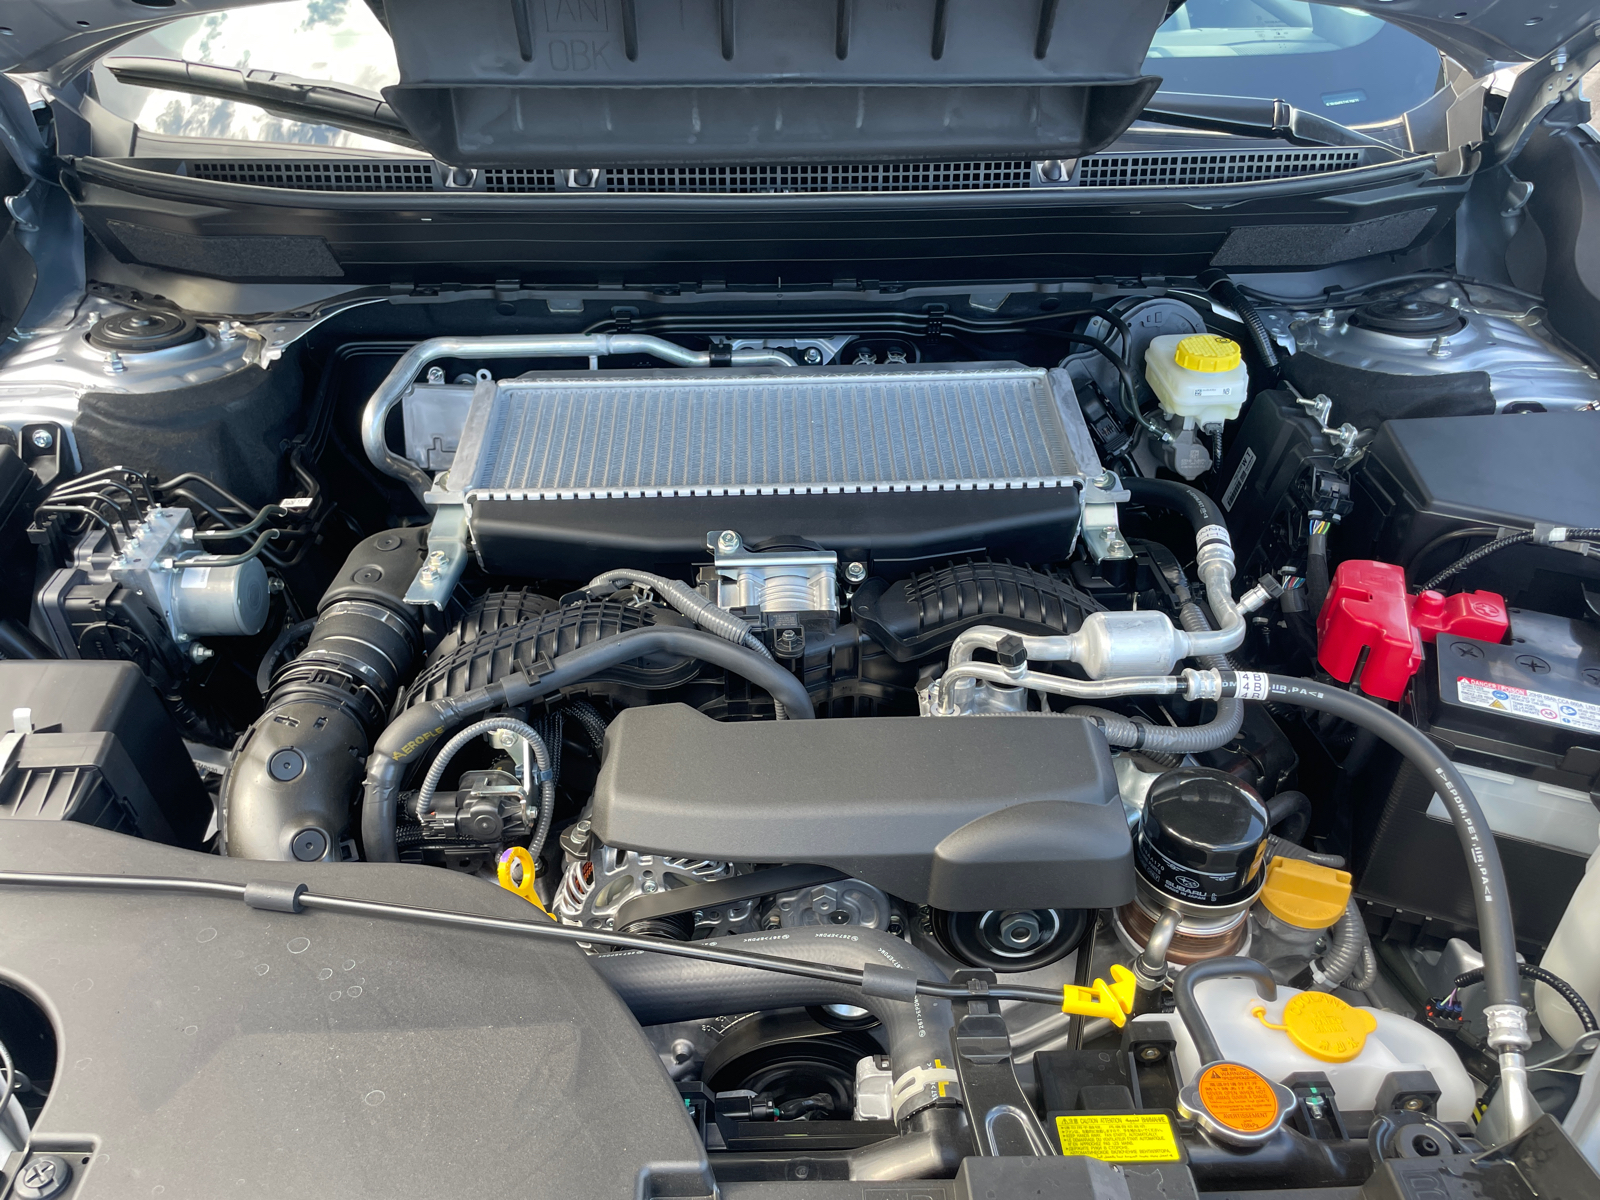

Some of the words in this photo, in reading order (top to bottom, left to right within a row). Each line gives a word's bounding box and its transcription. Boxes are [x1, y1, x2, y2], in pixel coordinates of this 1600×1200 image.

[548, 39, 612, 72] OBK
[1470, 679, 1497, 690] DANGER
[1165, 879, 1207, 897] SUBARU
[1289, 993, 1349, 1016] COOLANT
